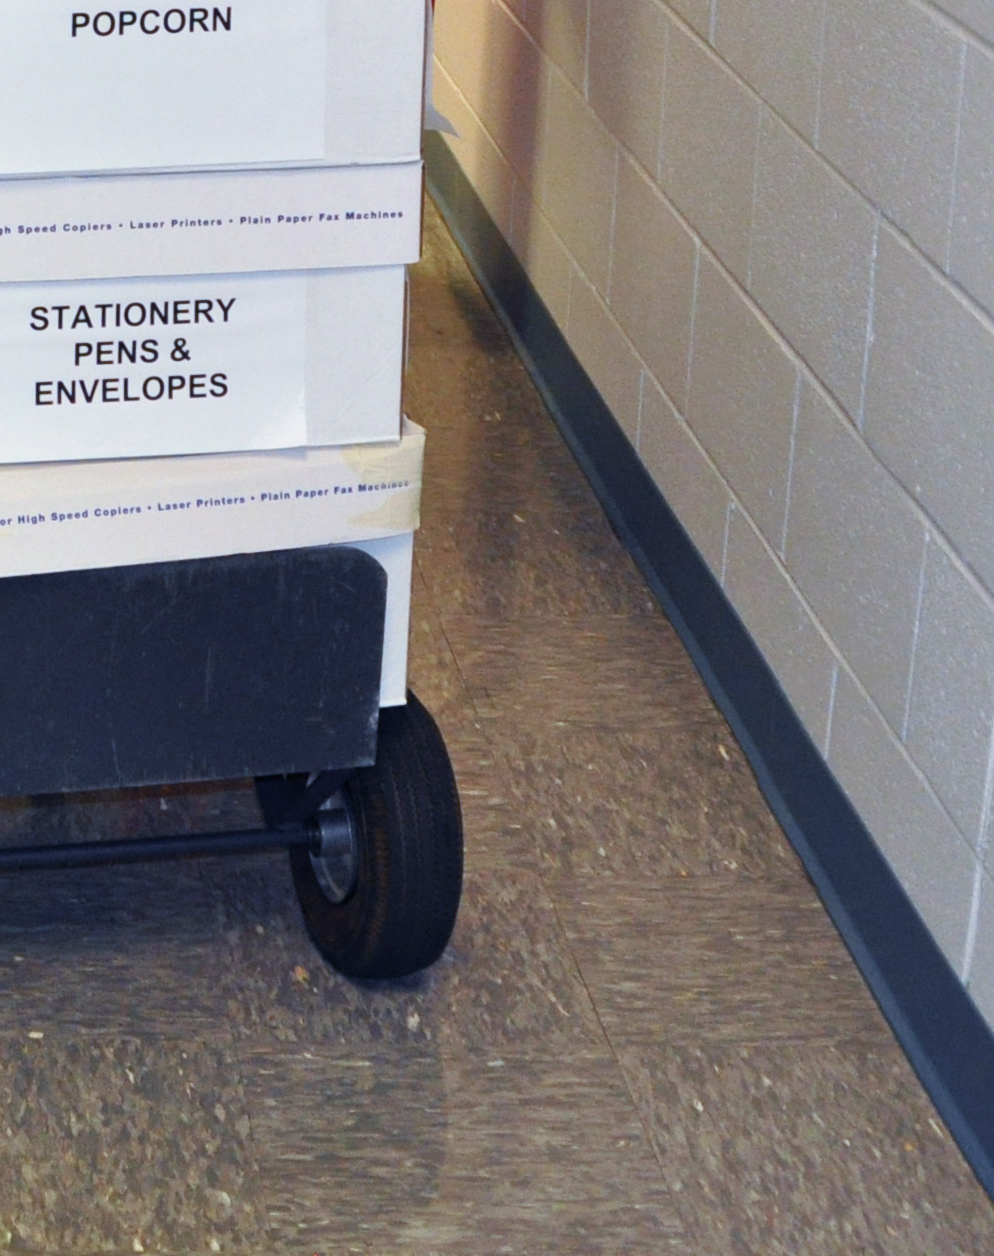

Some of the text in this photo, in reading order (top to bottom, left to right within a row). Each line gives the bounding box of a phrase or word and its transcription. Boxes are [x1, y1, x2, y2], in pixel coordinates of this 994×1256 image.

[71, 6, 232, 38] POPCORN
[18, 223, 57, 235] Speed
[63, 222, 112, 234] Copiers
[130, 220, 165, 230] Laser
[171, 218, 223, 229] Printers
[240, 215, 271, 226] Plain
[277, 214, 313, 226] Paper
[319, 212, 339, 222] Fax
[345, 210, 404, 221] Machines
[29, 298, 237, 331] STATIONERY
[74, 337, 191, 366] PENS &
[35, 373, 229, 406] ENVELOPES
[18, 513, 45, 526] High
[51, 509, 89, 523] Speed
[94, 506, 142, 518] Copiers
[158, 500, 191, 512] Laser
[196, 495, 245, 508] Printers
[260, 491, 290, 502] Plain
[296, 487, 329, 499] Paper
[334, 484, 353, 495] Fax
[358, 480, 409, 493] Machines
